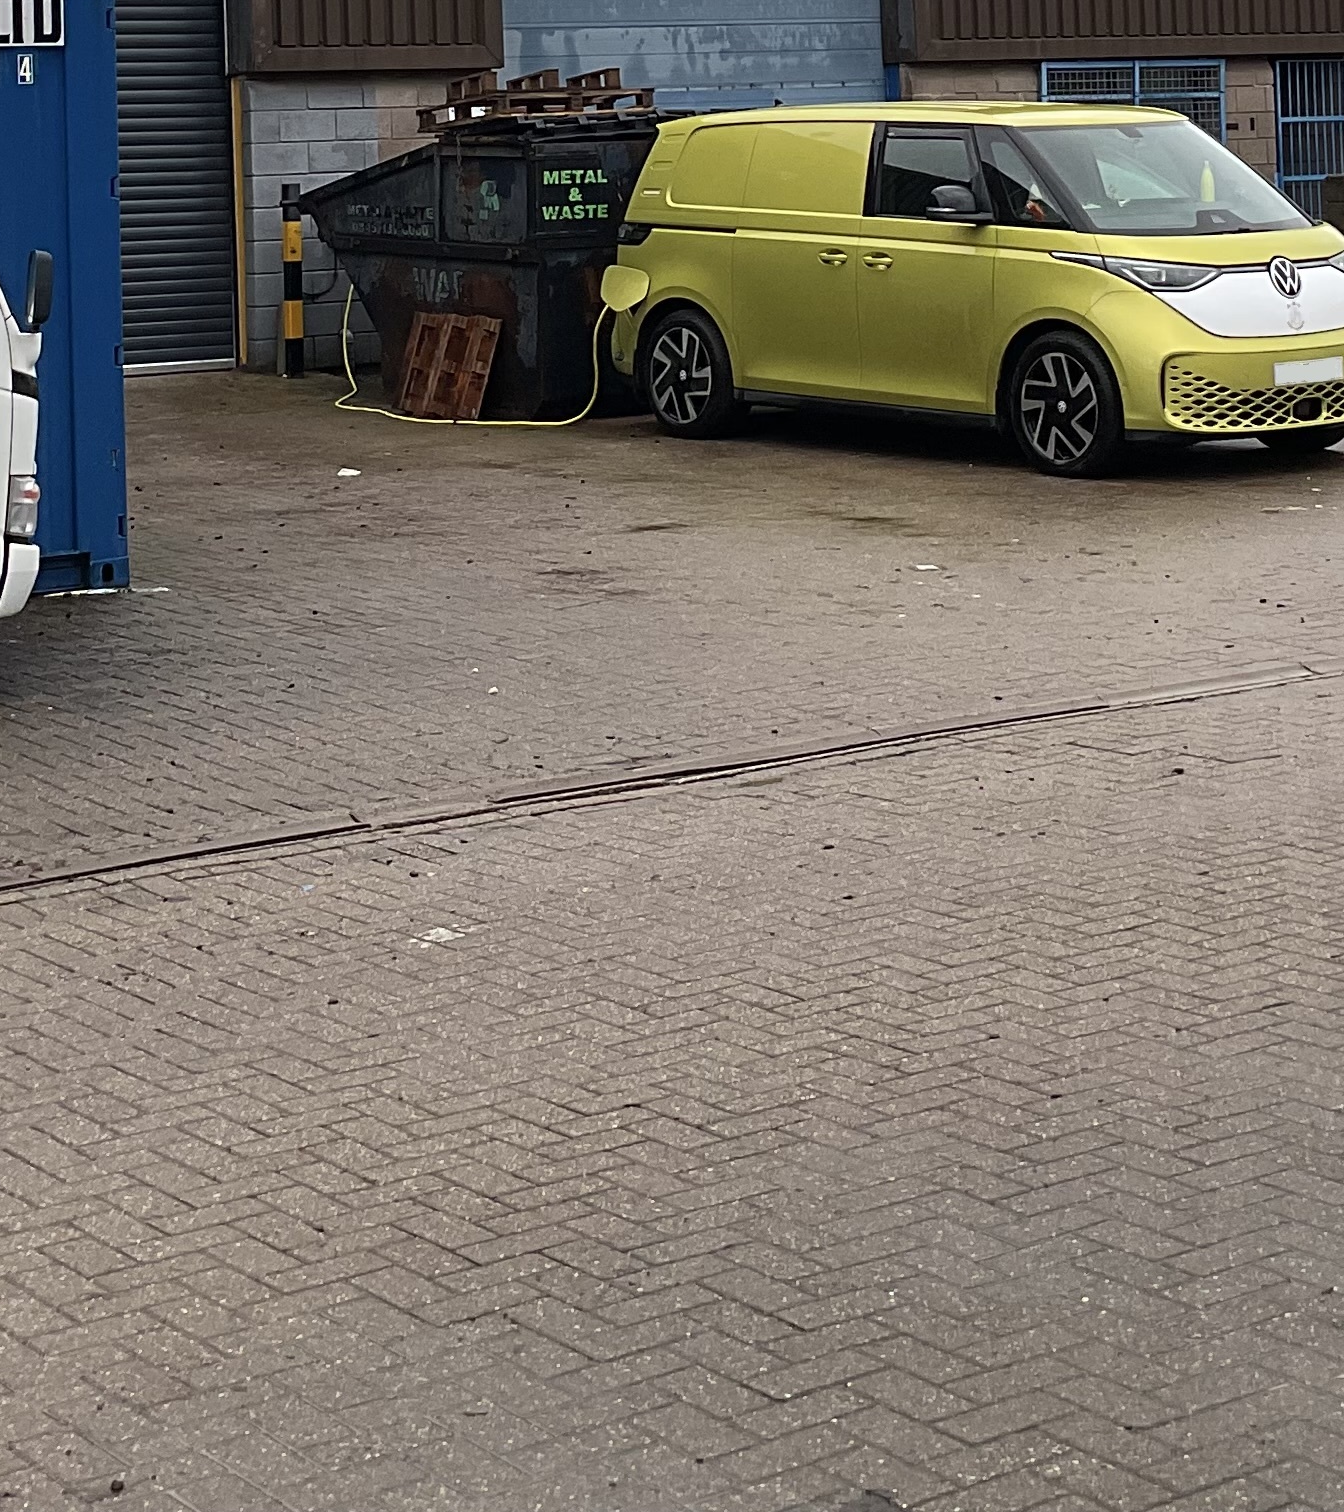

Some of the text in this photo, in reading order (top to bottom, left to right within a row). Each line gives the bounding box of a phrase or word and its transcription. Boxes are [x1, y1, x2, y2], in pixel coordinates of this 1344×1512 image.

[542, 169, 608, 185] METAL
[568, 187, 583, 201] &
[541, 204, 609, 220] WASTE
